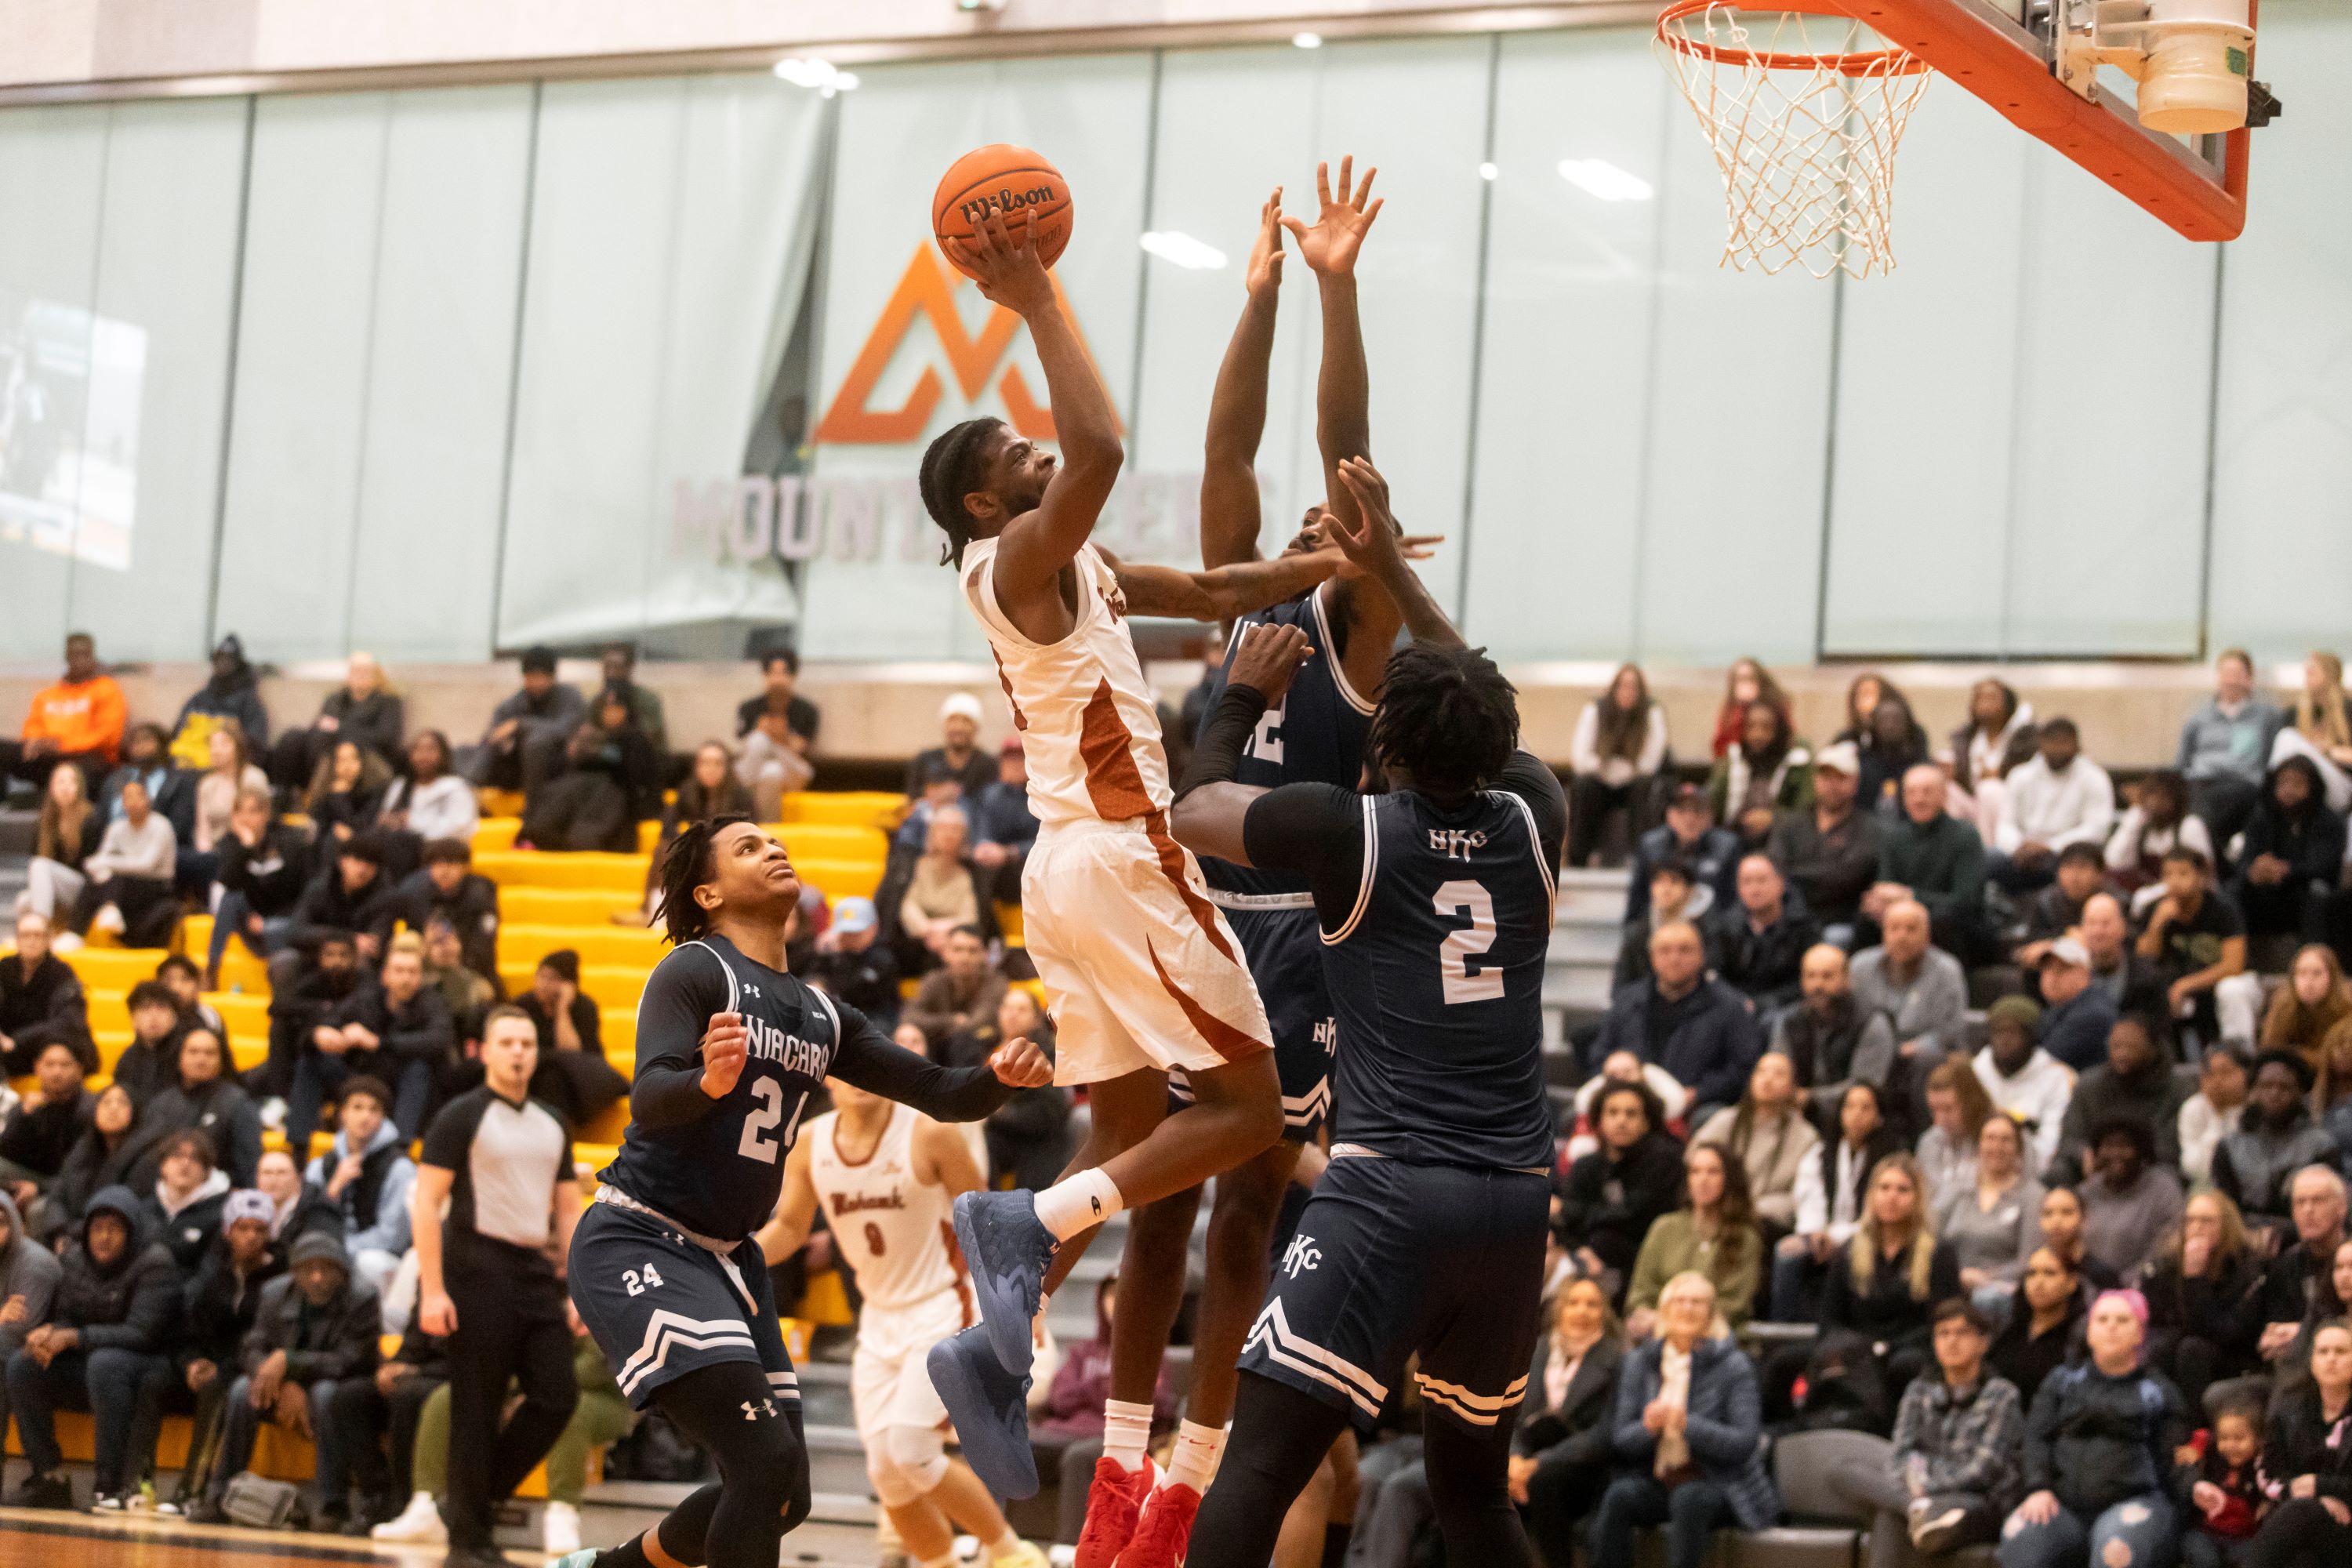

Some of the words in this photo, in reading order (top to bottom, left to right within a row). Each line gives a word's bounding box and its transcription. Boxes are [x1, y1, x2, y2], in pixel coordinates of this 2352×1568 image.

[960, 183, 1056, 226] Wilson
[1243, 693, 1285, 767] 2
[1432, 879, 1505, 1005] 2
[746, 1014, 830, 1085] NIAGARA
[1312, 1016, 1336, 1058] NK
[1282, 1234, 1323, 1279] NKC
[622, 1262, 664, 1297] 24
